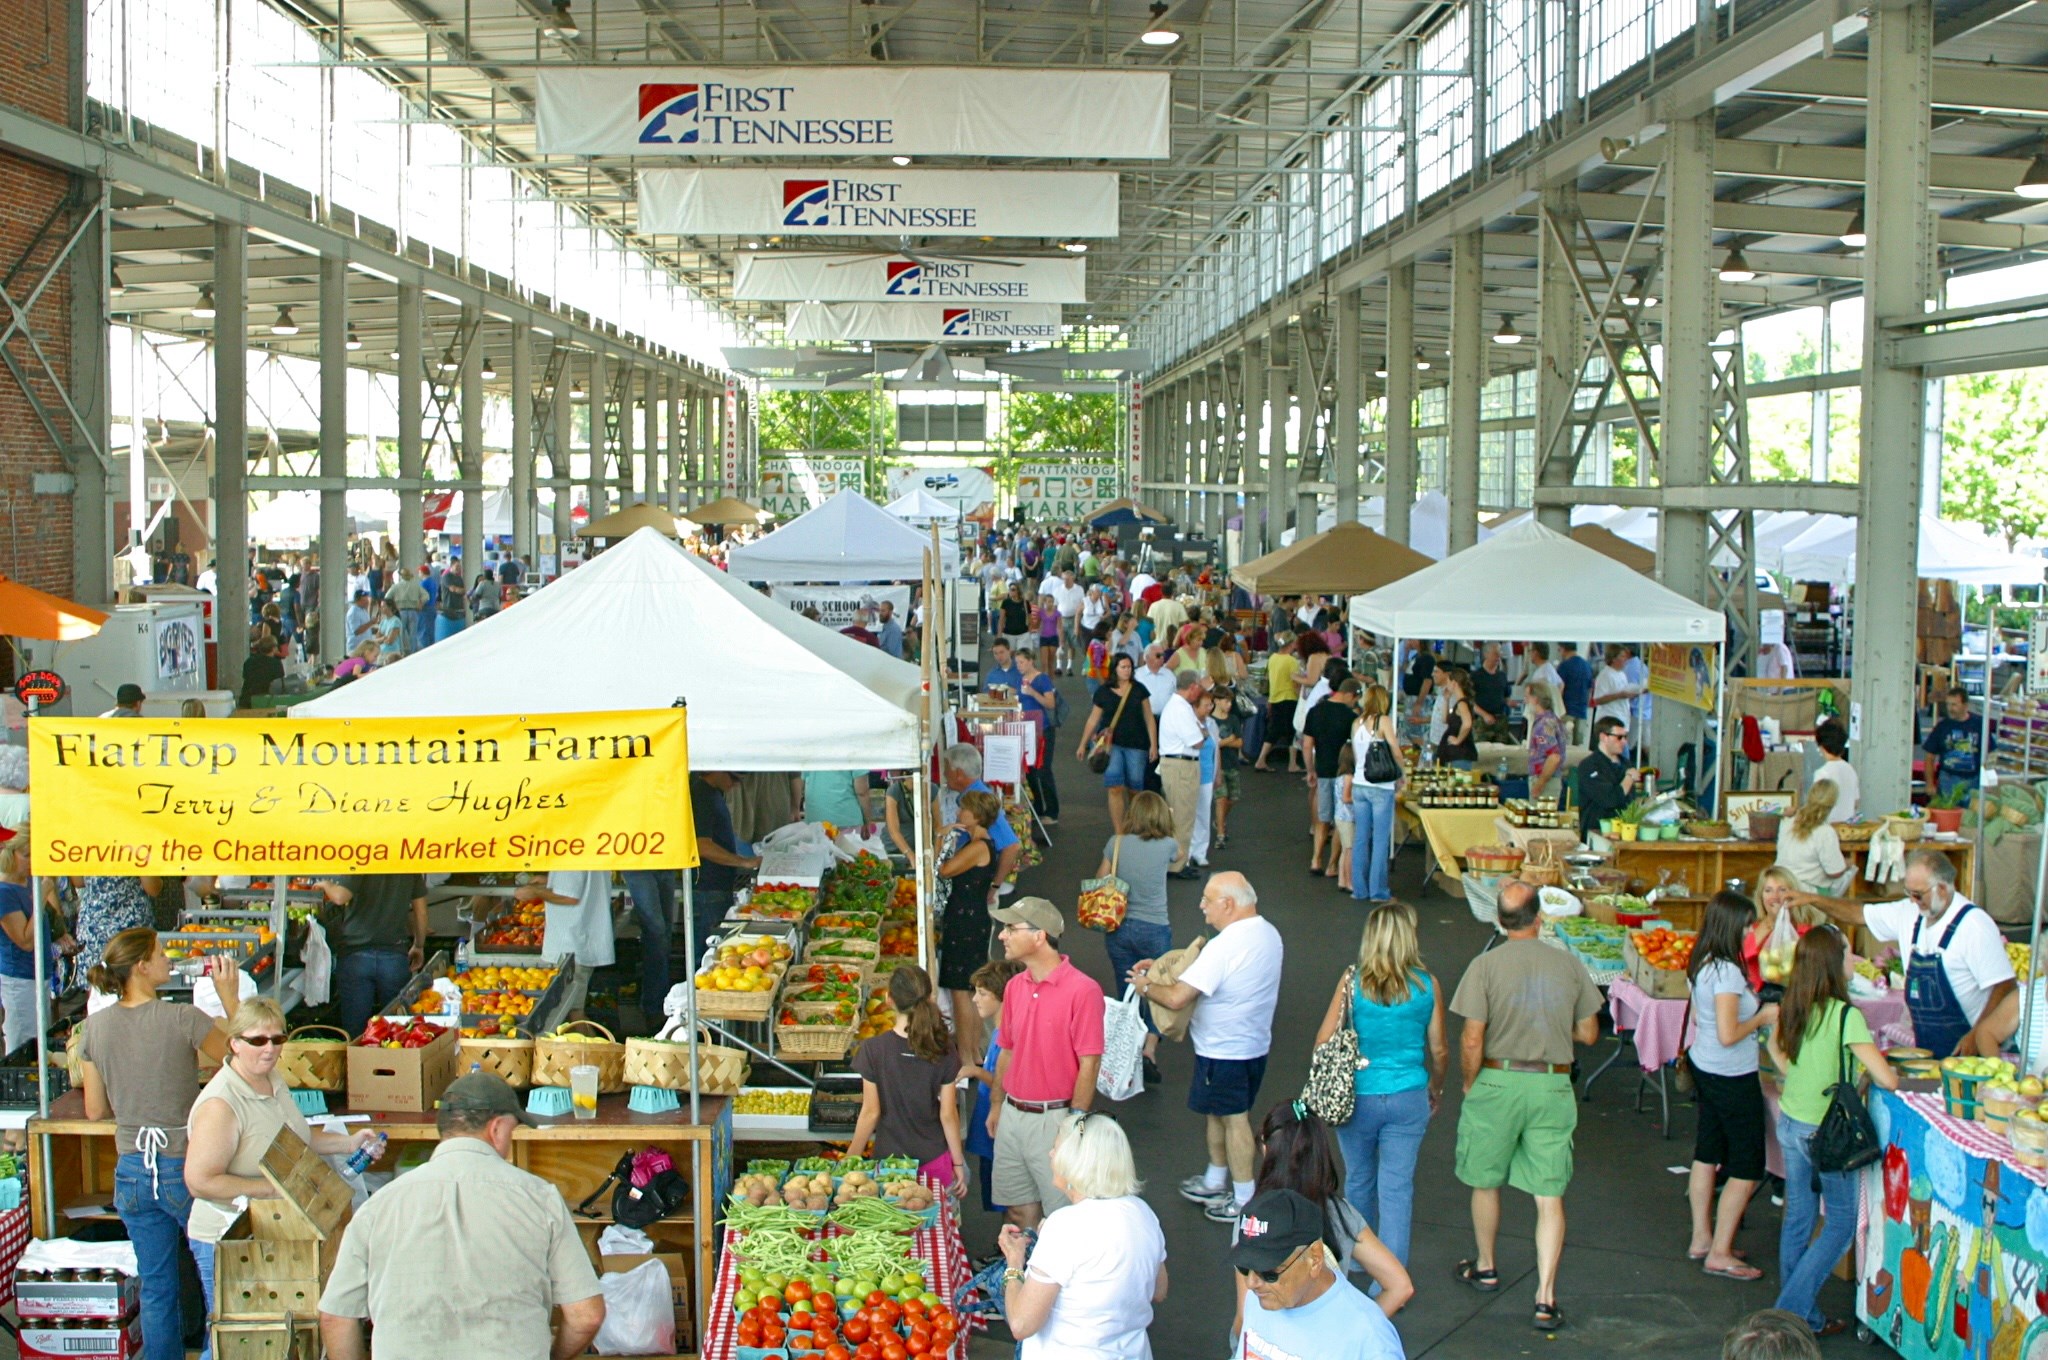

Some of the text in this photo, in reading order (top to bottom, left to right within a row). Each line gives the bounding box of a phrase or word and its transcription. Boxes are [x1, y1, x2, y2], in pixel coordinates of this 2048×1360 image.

[703, 83, 794, 112] FIRST
[703, 116, 893, 144] TENNESSEE
[832, 179, 902, 201] FIRST
[831, 204, 977, 227] TENNESSEE
[923, 261, 974, 278] FIRST
[922, 279, 1028, 297] TENNESSEE
[971, 309, 1012, 322] FIRST
[971, 323, 1055, 336] TENNESSEE
[1132, 383, 1142, 461] HAMILTON
[764, 461, 861, 472] CHANOOGA
[924, 473, 959, 491] epb
[1020, 501, 1112, 516] MARKE
[138, 623, 148, 634] K4
[19, 672, 37, 688] HOT
[51, 727, 654, 774] FlatTop Mountain Farm
[137, 777, 569, 825] Terry & Diane Hughes
[50, 831, 665, 867] Serving the Chattanooga Market Since 2002
